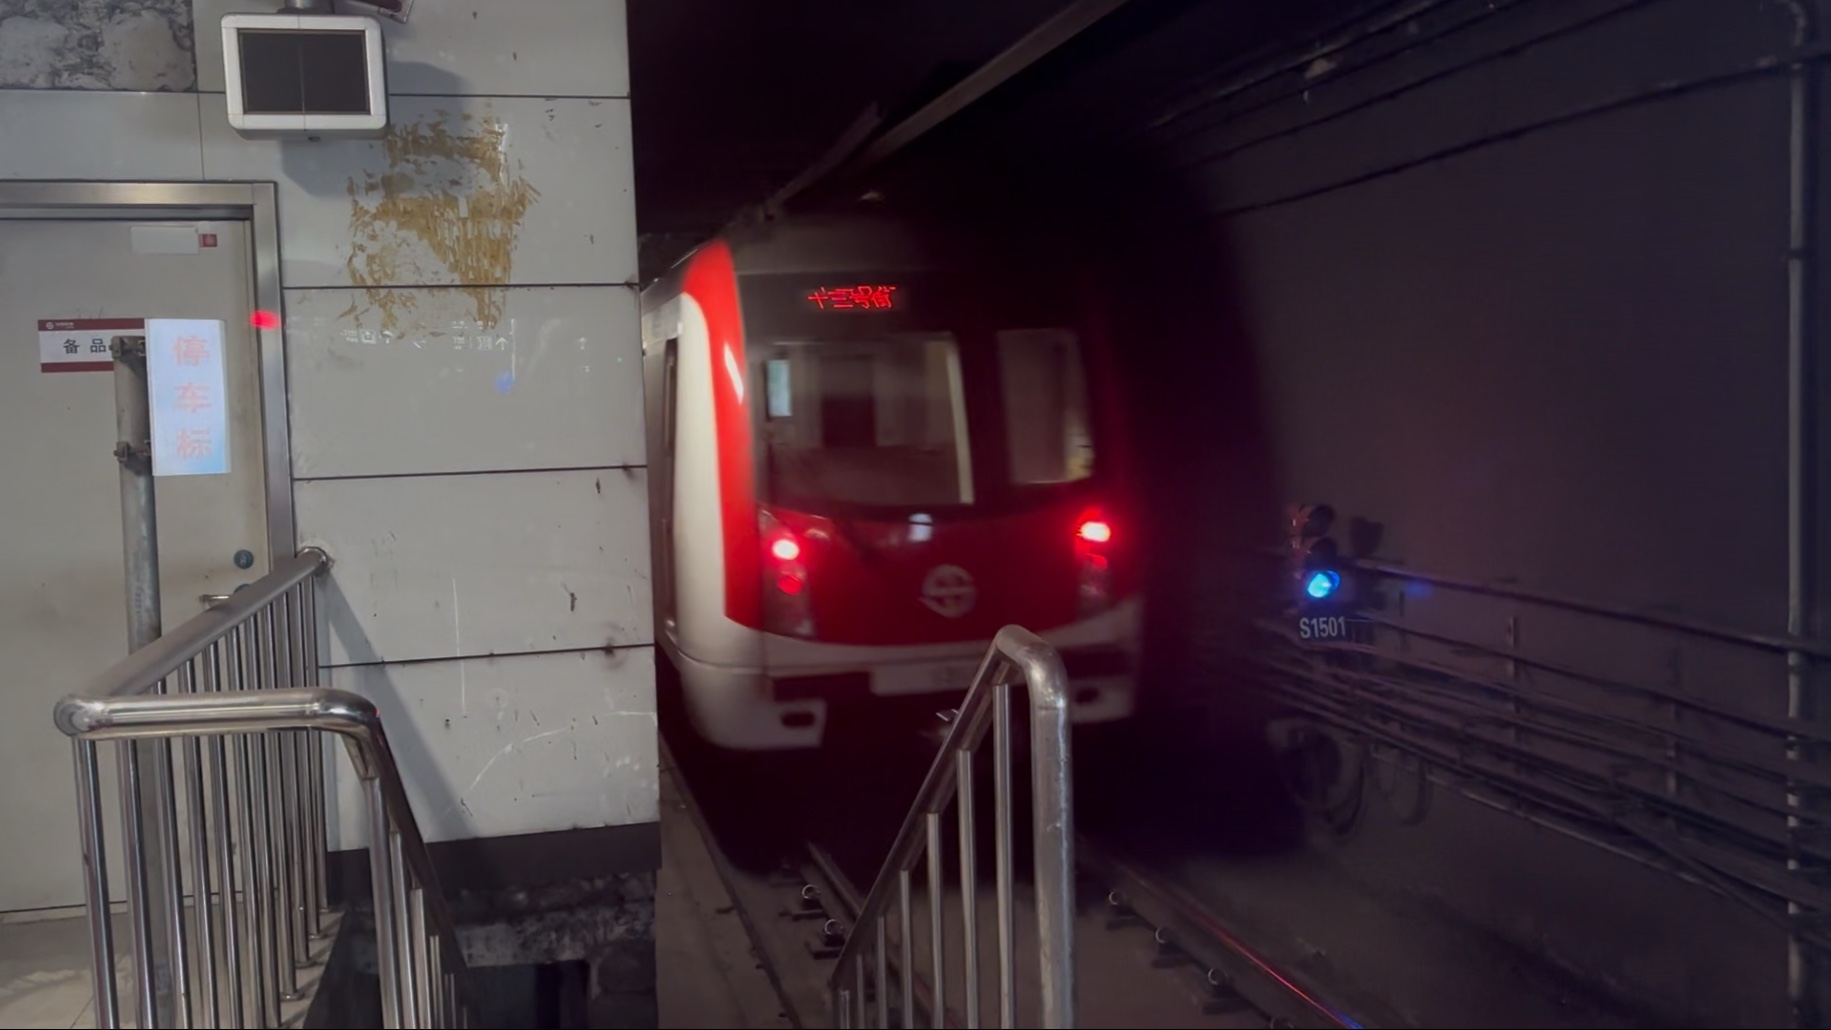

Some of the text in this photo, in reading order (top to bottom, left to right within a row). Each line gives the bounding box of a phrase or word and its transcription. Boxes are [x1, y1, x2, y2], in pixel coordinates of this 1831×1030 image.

[172, 335, 213, 460] 停车标
[1299, 616, 1346, 639] S1501
